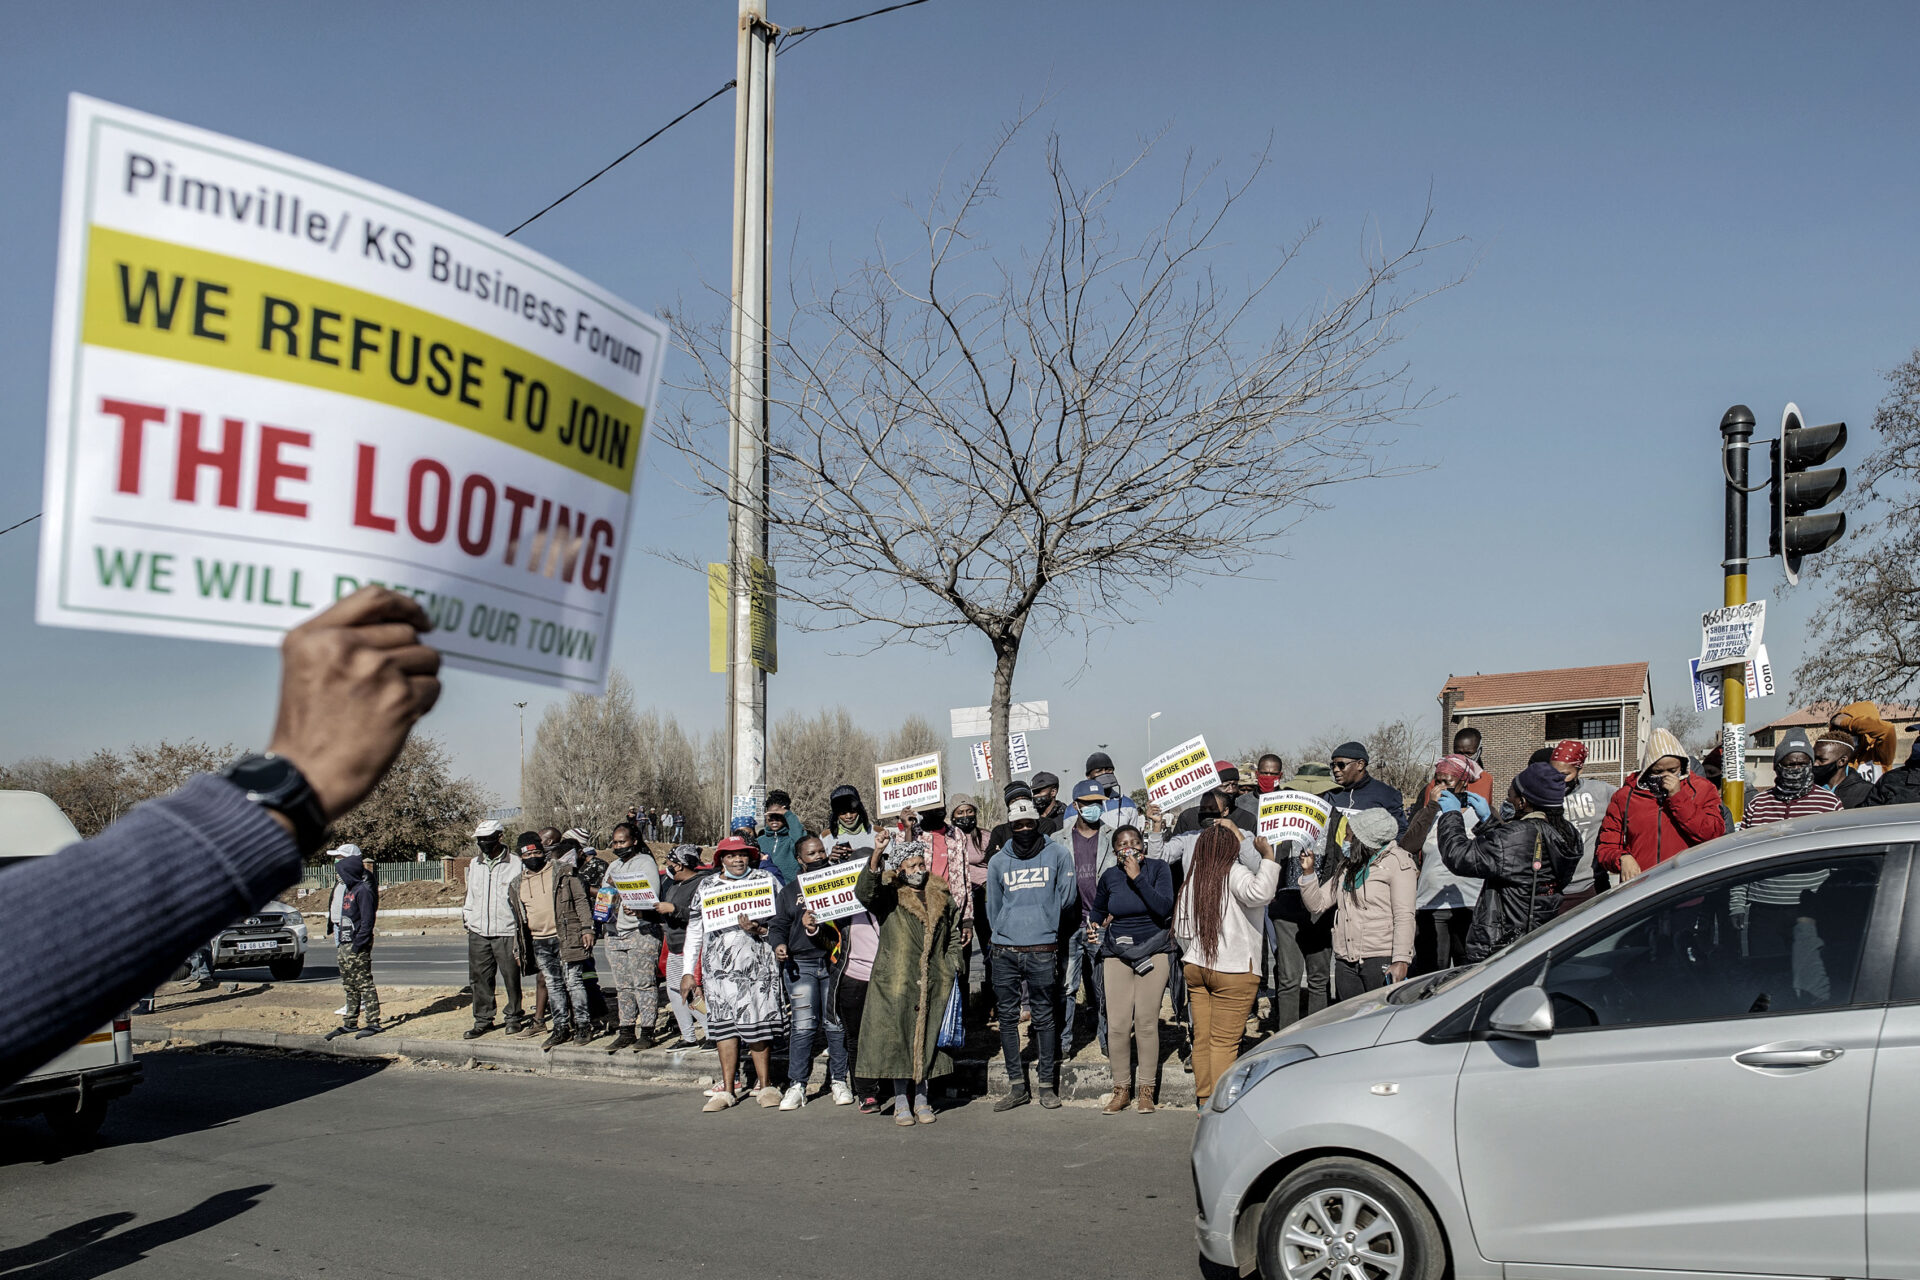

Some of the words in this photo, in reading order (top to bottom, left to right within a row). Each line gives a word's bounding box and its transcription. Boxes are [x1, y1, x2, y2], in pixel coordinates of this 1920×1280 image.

[124, 152, 349, 252] Pimville/
[363, 220, 415, 270] KS
[429, 245, 566, 336] Business
[577, 312, 643, 376] Forum
[116, 262, 229, 343] WE
[258, 294, 485, 408] REFUSE
[502, 368, 548, 435] TO
[557, 396, 632, 470] JOIN
[99, 396, 313, 519] THE
[351, 443, 616, 595] LOOTING
[93, 545, 175, 594] WE
[195, 557, 314, 609] WILL
[334, 574, 465, 632] DND
[468, 605, 518, 645] OUR
[527, 617, 597, 664] TOWN
[1710, 624, 1729, 634] SHORT
[1695, 682, 1704, 712] GAUTENG
[894, 773, 914, 783] REFUSE
[924, 768, 936, 776] JOIN
[1147, 776, 1155, 786] WE
[1156, 763, 1179, 780] REFUSE
[1180, 758, 1189, 768] TO
[1191, 750, 1206, 763] JOIN
[883, 789, 900, 800] THE
[902, 781, 937, 797] LOOTING
[1150, 785, 1169, 800] THE
[1169, 763, 1212, 791] LOOTING
[1174, 790, 1191, 800] DEFEND
[1203, 778, 1216, 788] TOWN
[1262, 806, 1272, 814] WE
[1305, 806, 1313, 815] TO
[1314, 812, 1326, 824] JOIN
[1261, 818, 1279, 832] THE
[1282, 817, 1320, 840] LOOTING
[832, 866, 854, 874] Business
[1003, 867, 1049, 885] UZZI
[806, 886, 817, 895] WE
[818, 878, 845, 892] REFUSE
[846, 876, 856, 884] TO
[629, 891, 655, 901] LOOTING
[717, 893, 742, 902] REFUSE
[809, 897, 830, 911] THE
[706, 907, 725, 920] THE
[728, 898, 772, 914] LOOTING
